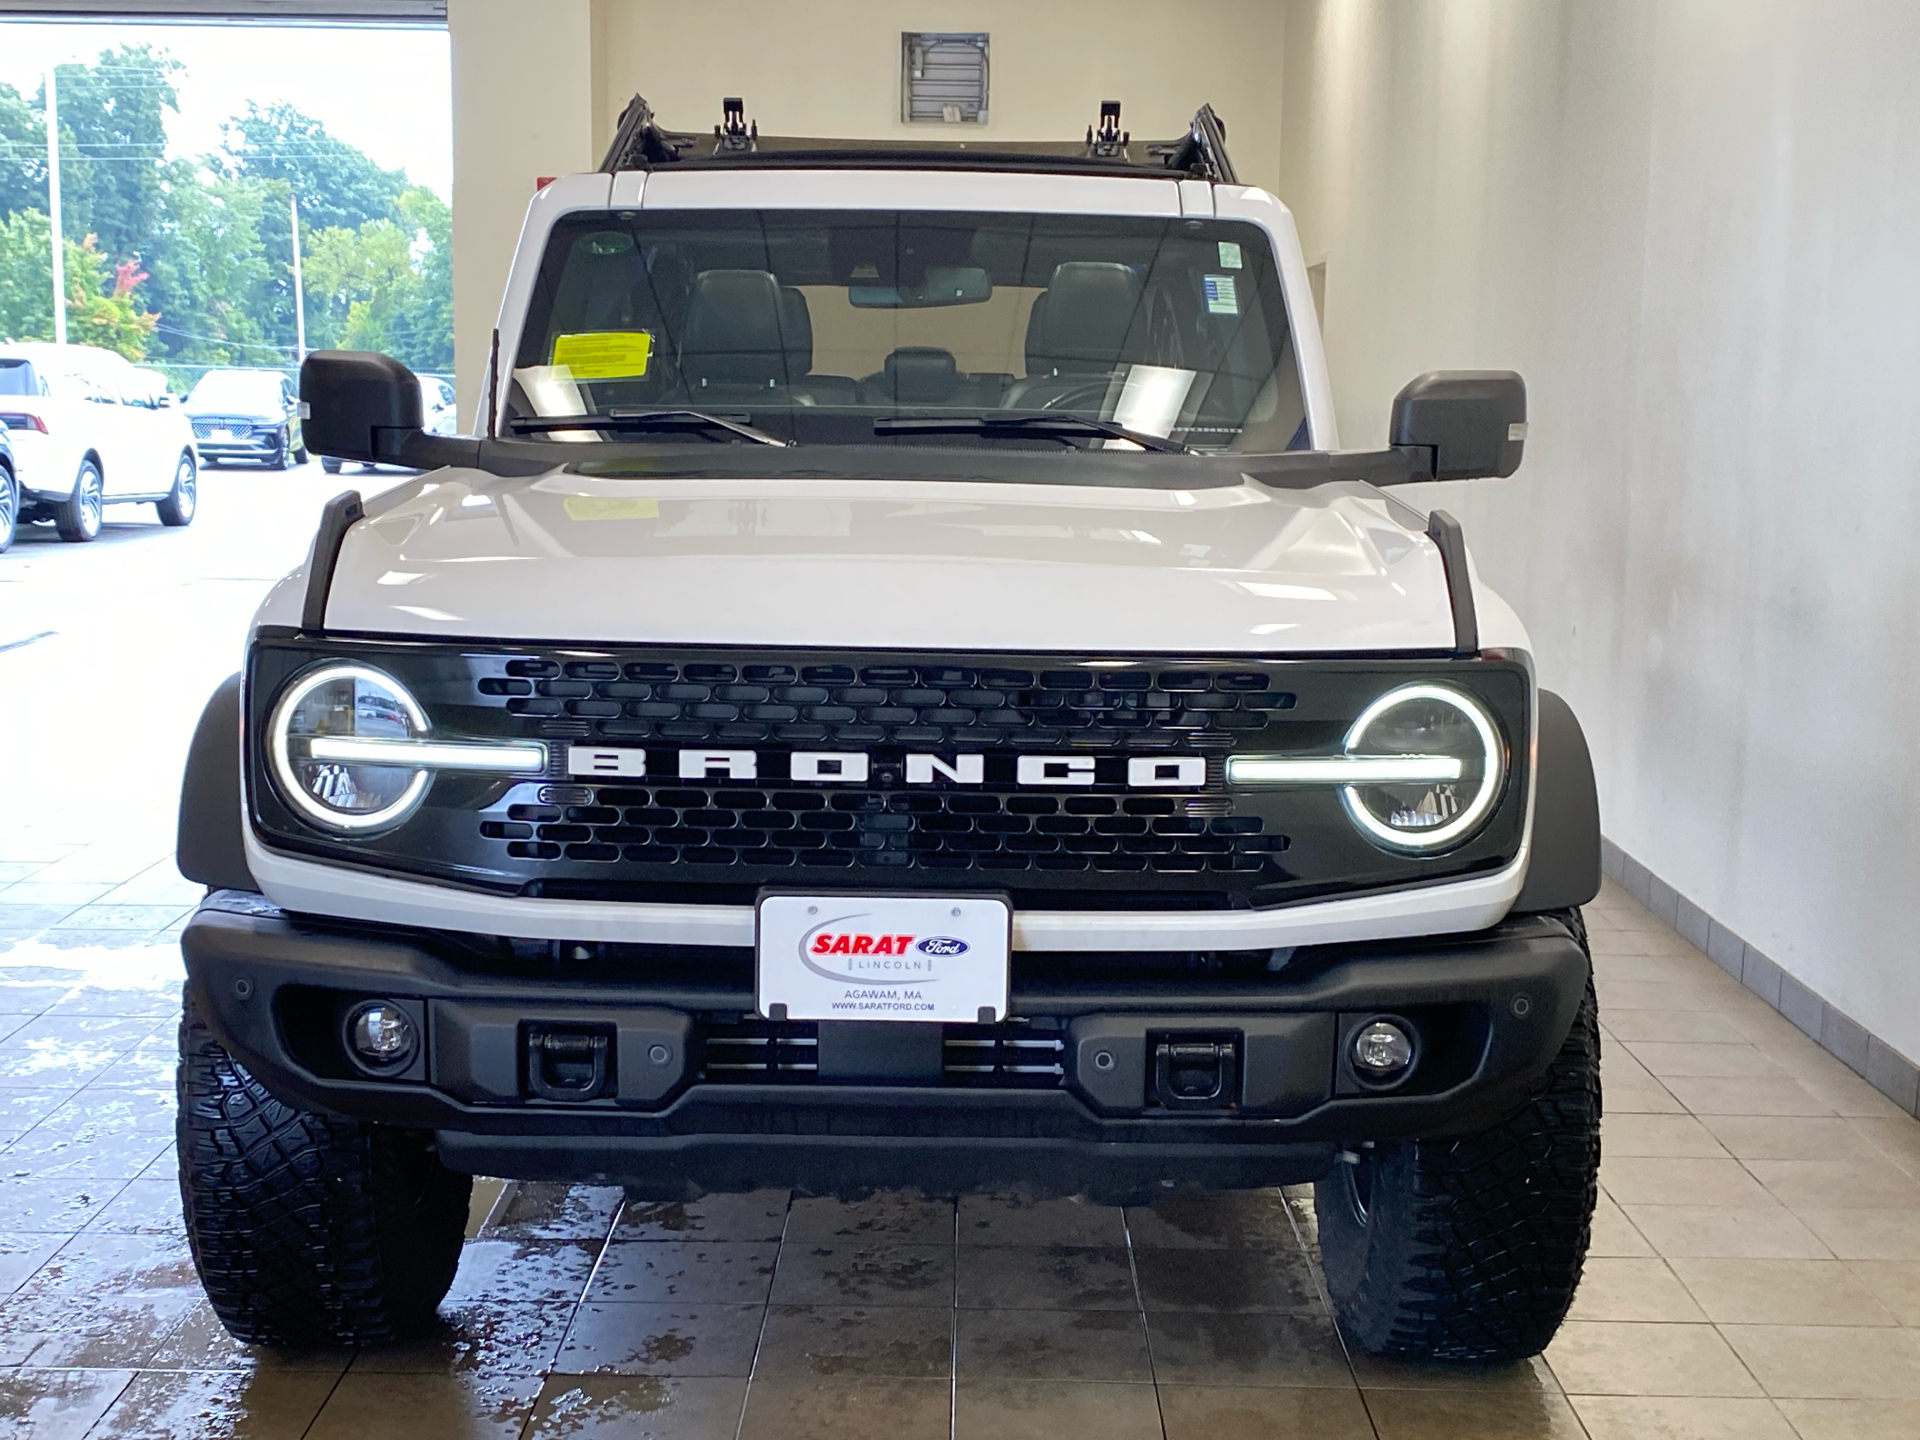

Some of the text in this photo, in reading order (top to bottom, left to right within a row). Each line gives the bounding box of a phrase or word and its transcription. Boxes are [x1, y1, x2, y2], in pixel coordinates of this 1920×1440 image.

[567, 746, 1206, 787] BRONCO
[811, 933, 961, 956] SARAT Ford
[858, 960, 922, 970] LINCOLN
[844, 990, 922, 1000] AGAWAM, MA
[831, 1002, 935, 1011] WWW.SARATFORD.COM
